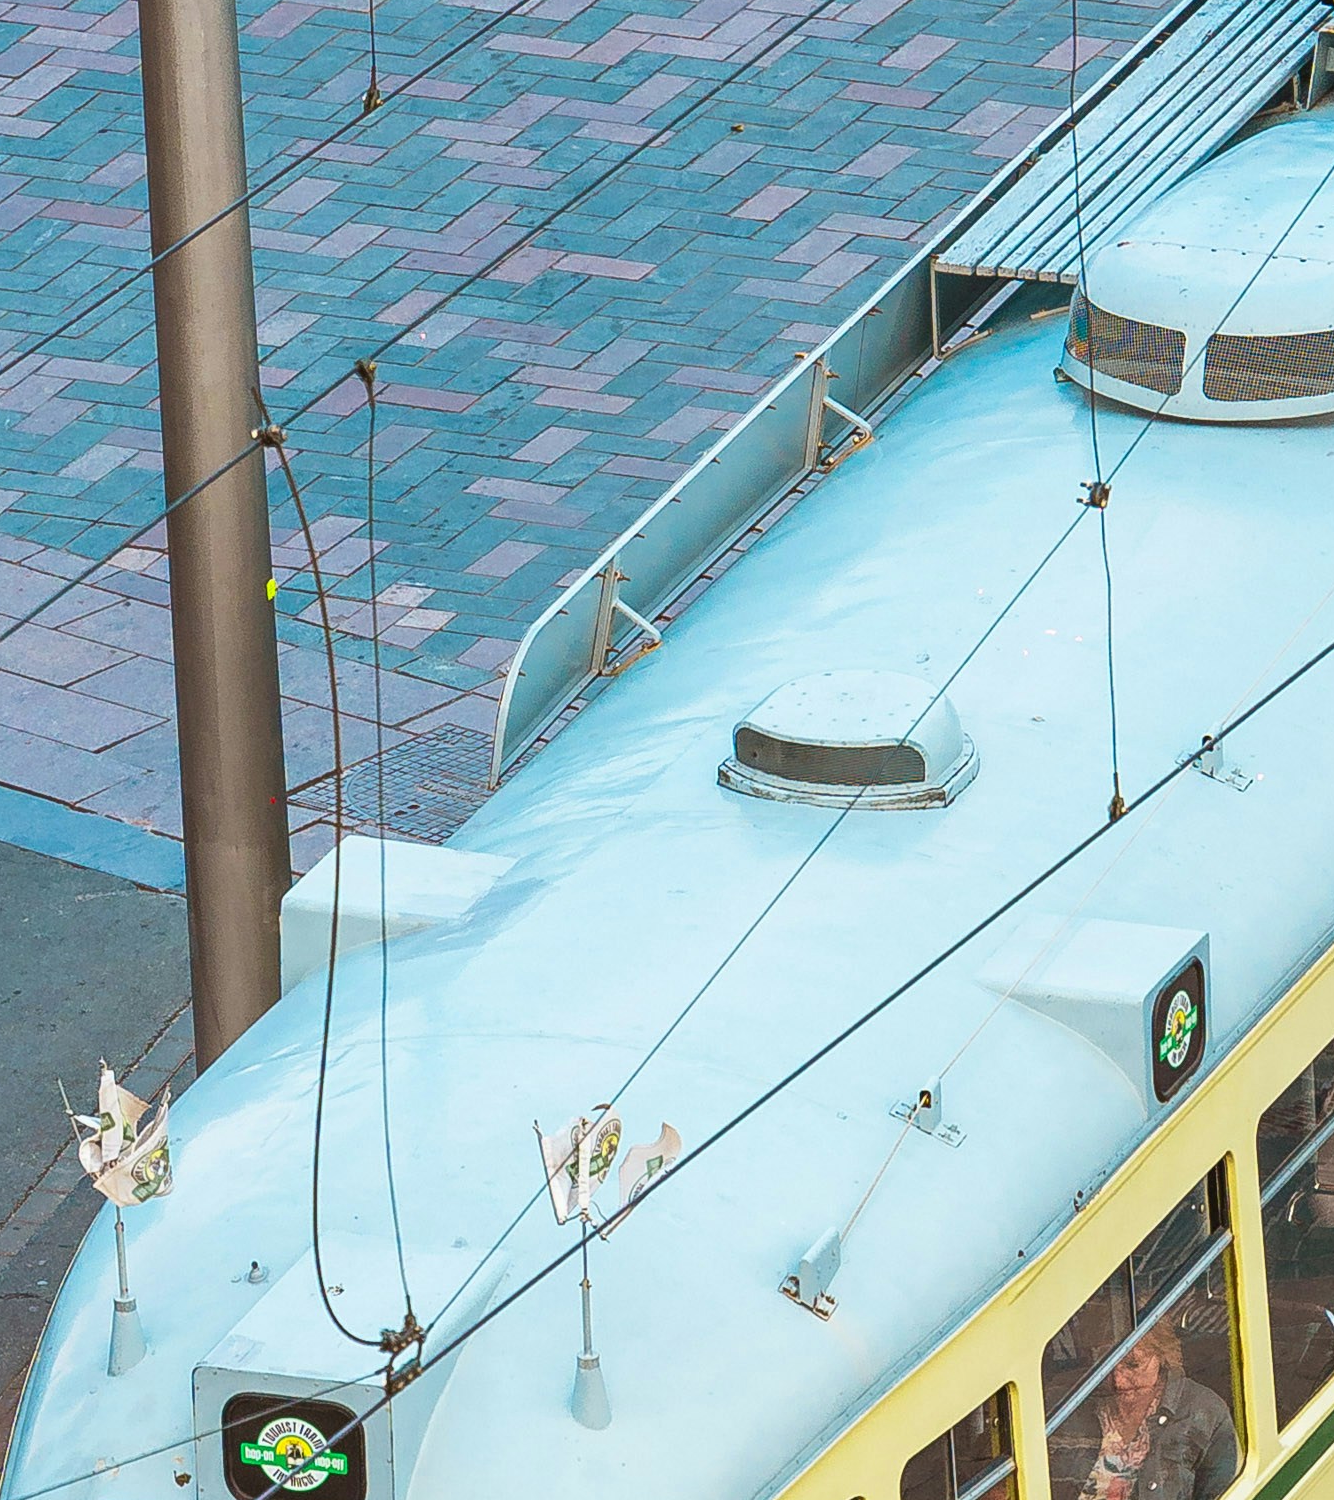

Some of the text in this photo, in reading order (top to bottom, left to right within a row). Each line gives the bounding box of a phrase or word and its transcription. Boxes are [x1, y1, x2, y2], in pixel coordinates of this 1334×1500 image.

[262, 1421, 326, 1450] TOURIST TRAM
[245, 1446, 274, 1462] hop-on
